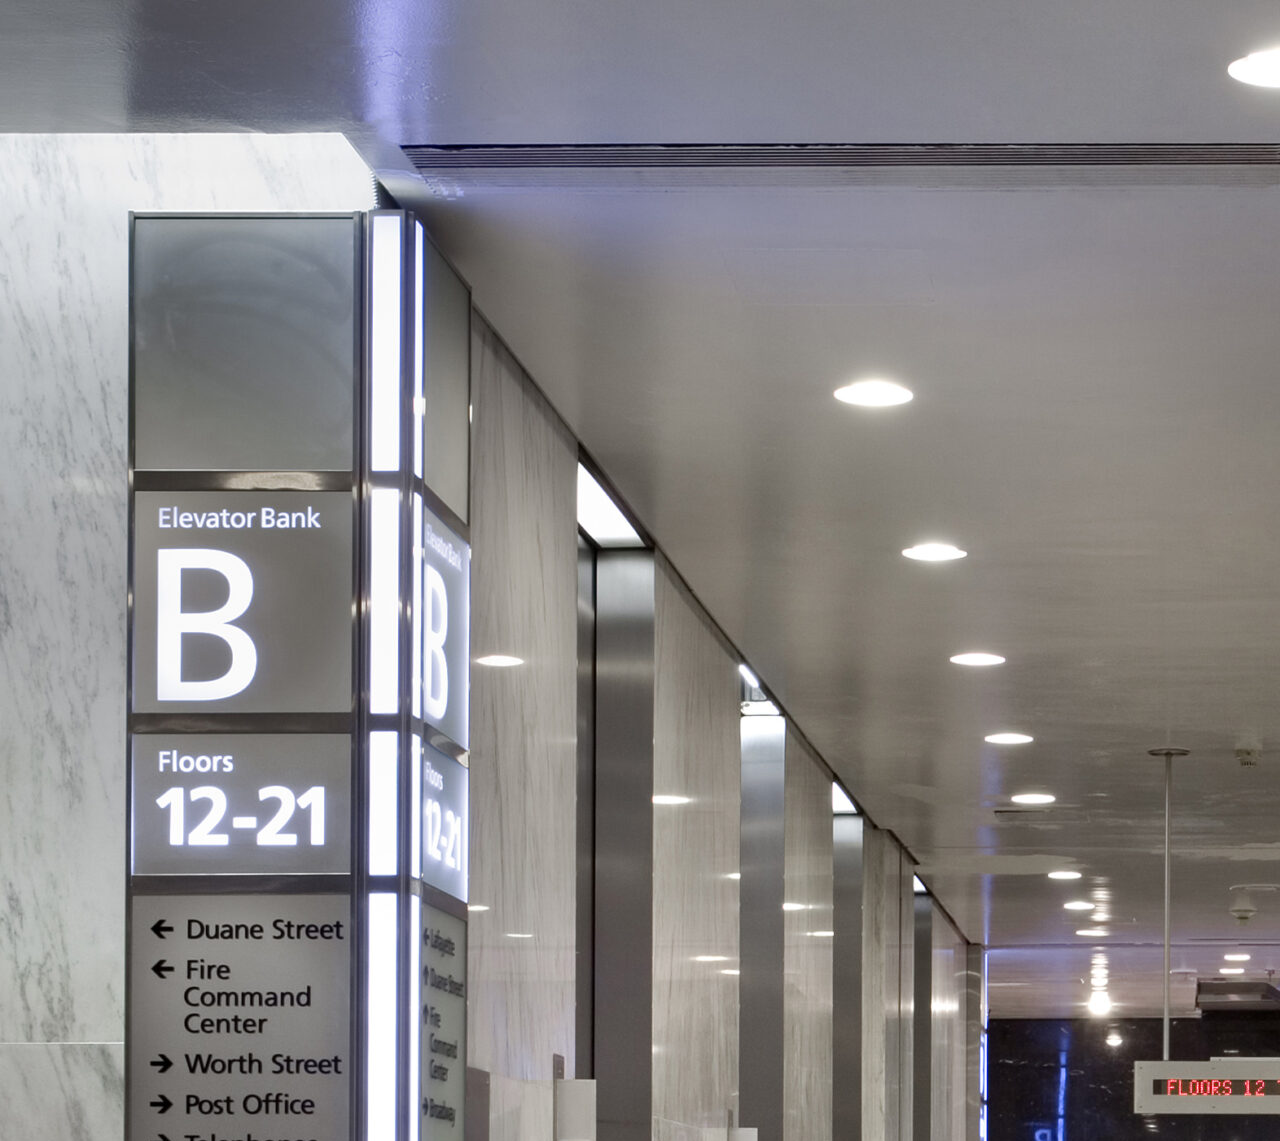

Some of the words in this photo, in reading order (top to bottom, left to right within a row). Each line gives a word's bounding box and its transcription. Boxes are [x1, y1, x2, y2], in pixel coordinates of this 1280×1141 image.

[159, 507, 256, 528] Elevator
[262, 507, 320, 528] Bank
[156, 548, 258, 701] B
[424, 563, 449, 720] B
[159, 750, 233, 772] Floors
[156, 785, 326, 846] 12-21
[425, 799, 461, 872] 12-21
[188, 919, 263, 939] Duane
[273, 919, 344, 939] Street
[187, 959, 230, 980] Fire
[184, 986, 311, 1007] Command
[184, 1013, 267, 1033] Center
[185, 1053, 262, 1074] Worth
[272, 1054, 342, 1074] Street
[1166, 1079, 1233, 1096] FLOORS
[1243, 1079, 1265, 1096] 12
[186, 1095, 234, 1115] Post
[243, 1093, 315, 1114] Office
